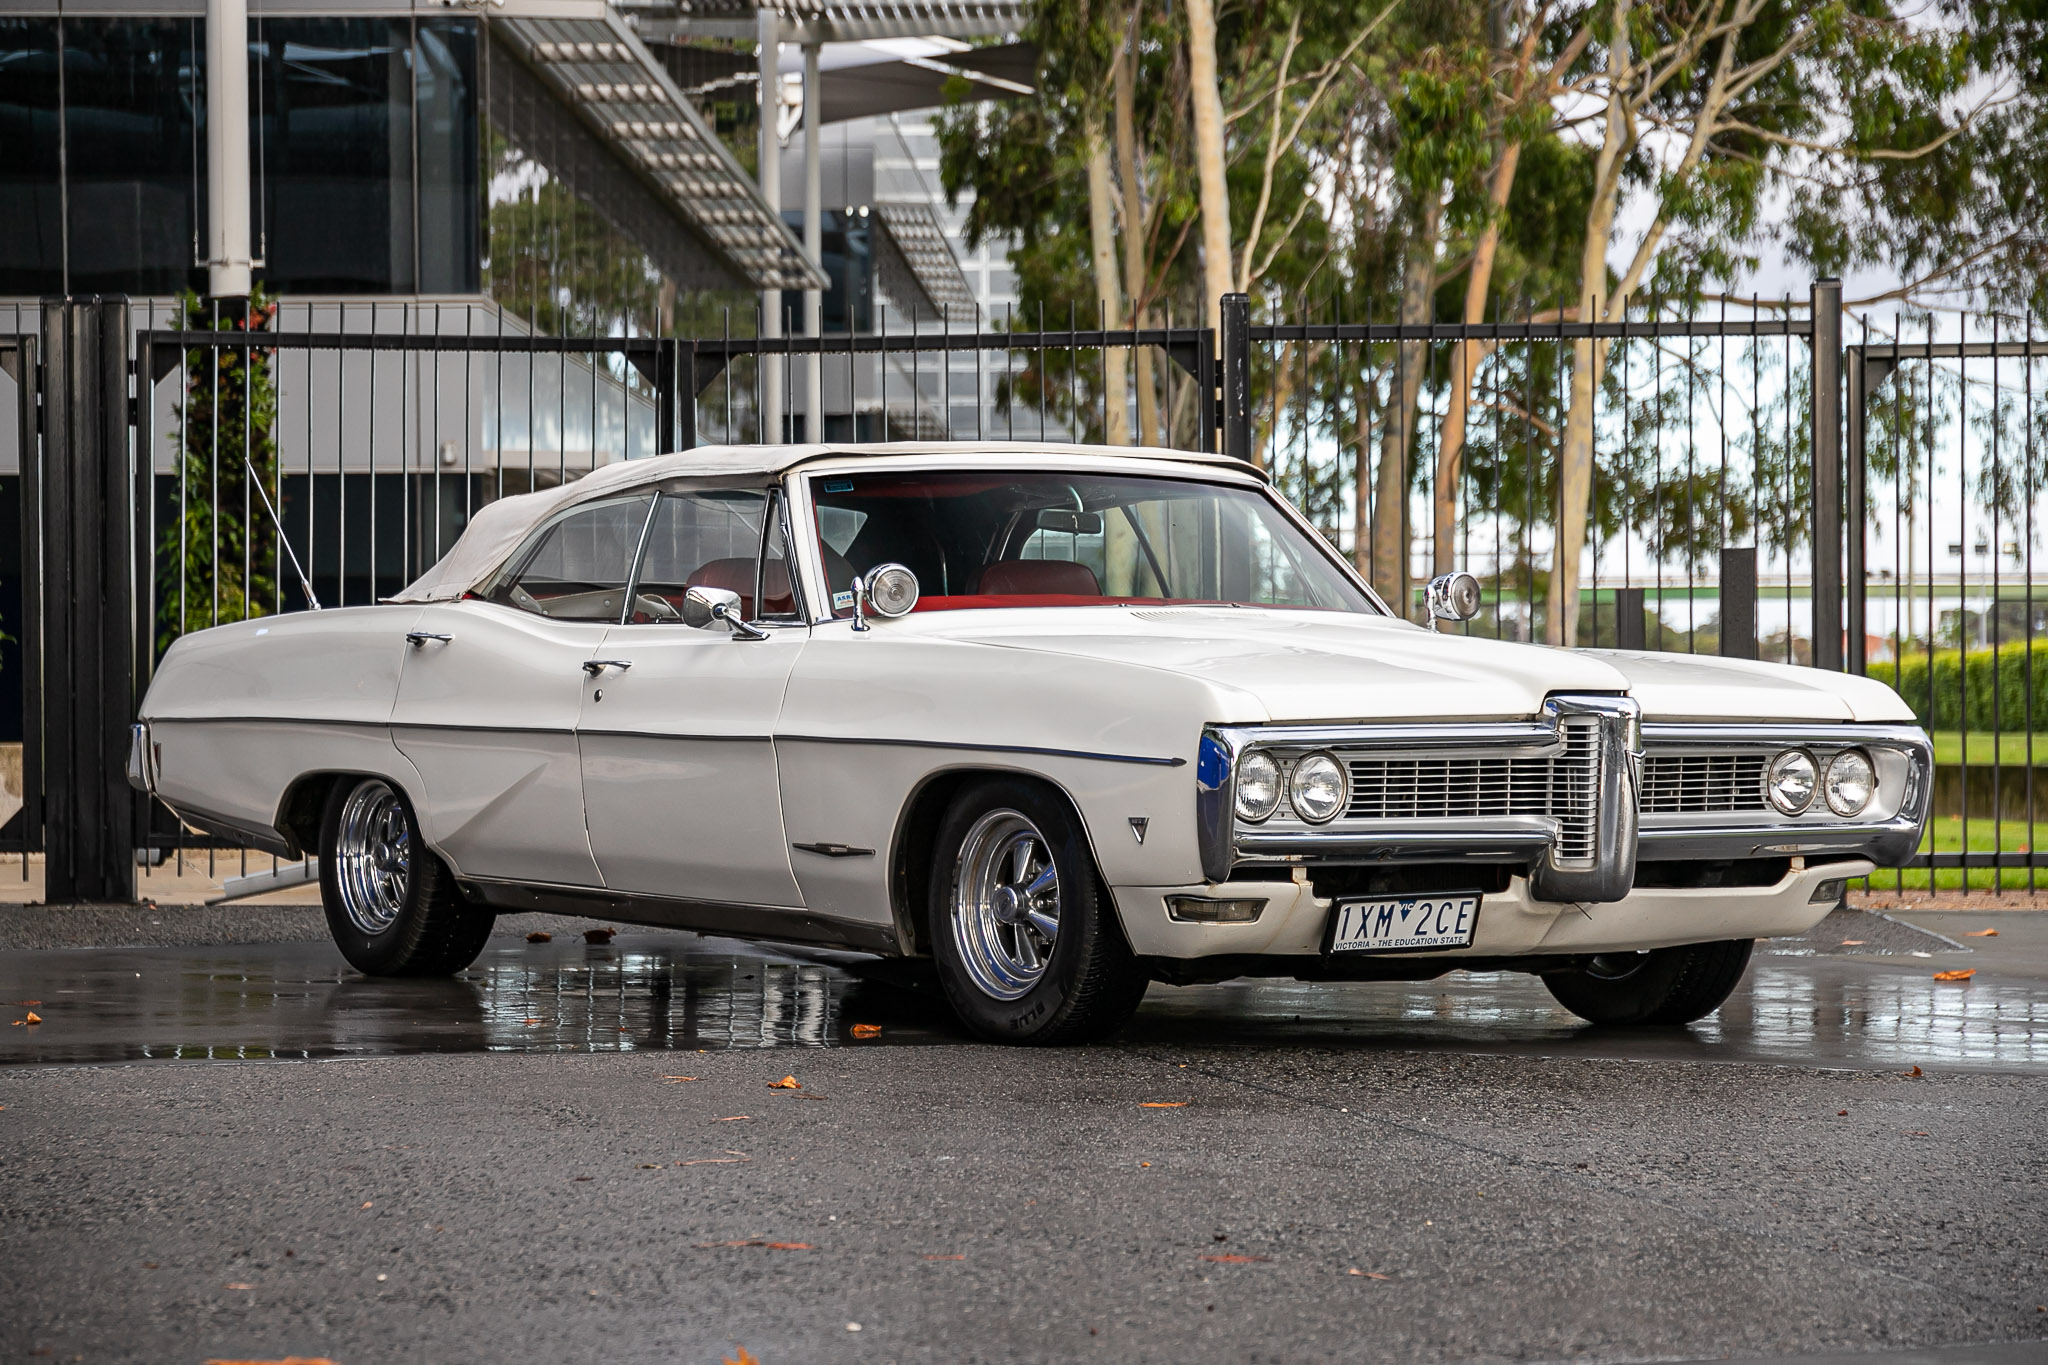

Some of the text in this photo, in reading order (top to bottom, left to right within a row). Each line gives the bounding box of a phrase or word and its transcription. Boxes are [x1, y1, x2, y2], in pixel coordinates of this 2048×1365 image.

[1400, 903, 1415, 911] VIC
[1341, 900, 1474, 940] 1XM 2CE
[1335, 941, 1370, 950] VICTORIA
[1378, 939, 1393, 947] THE
[1394, 937, 1439, 946] EDUCATION
[1440, 936, 1464, 944] STATE
